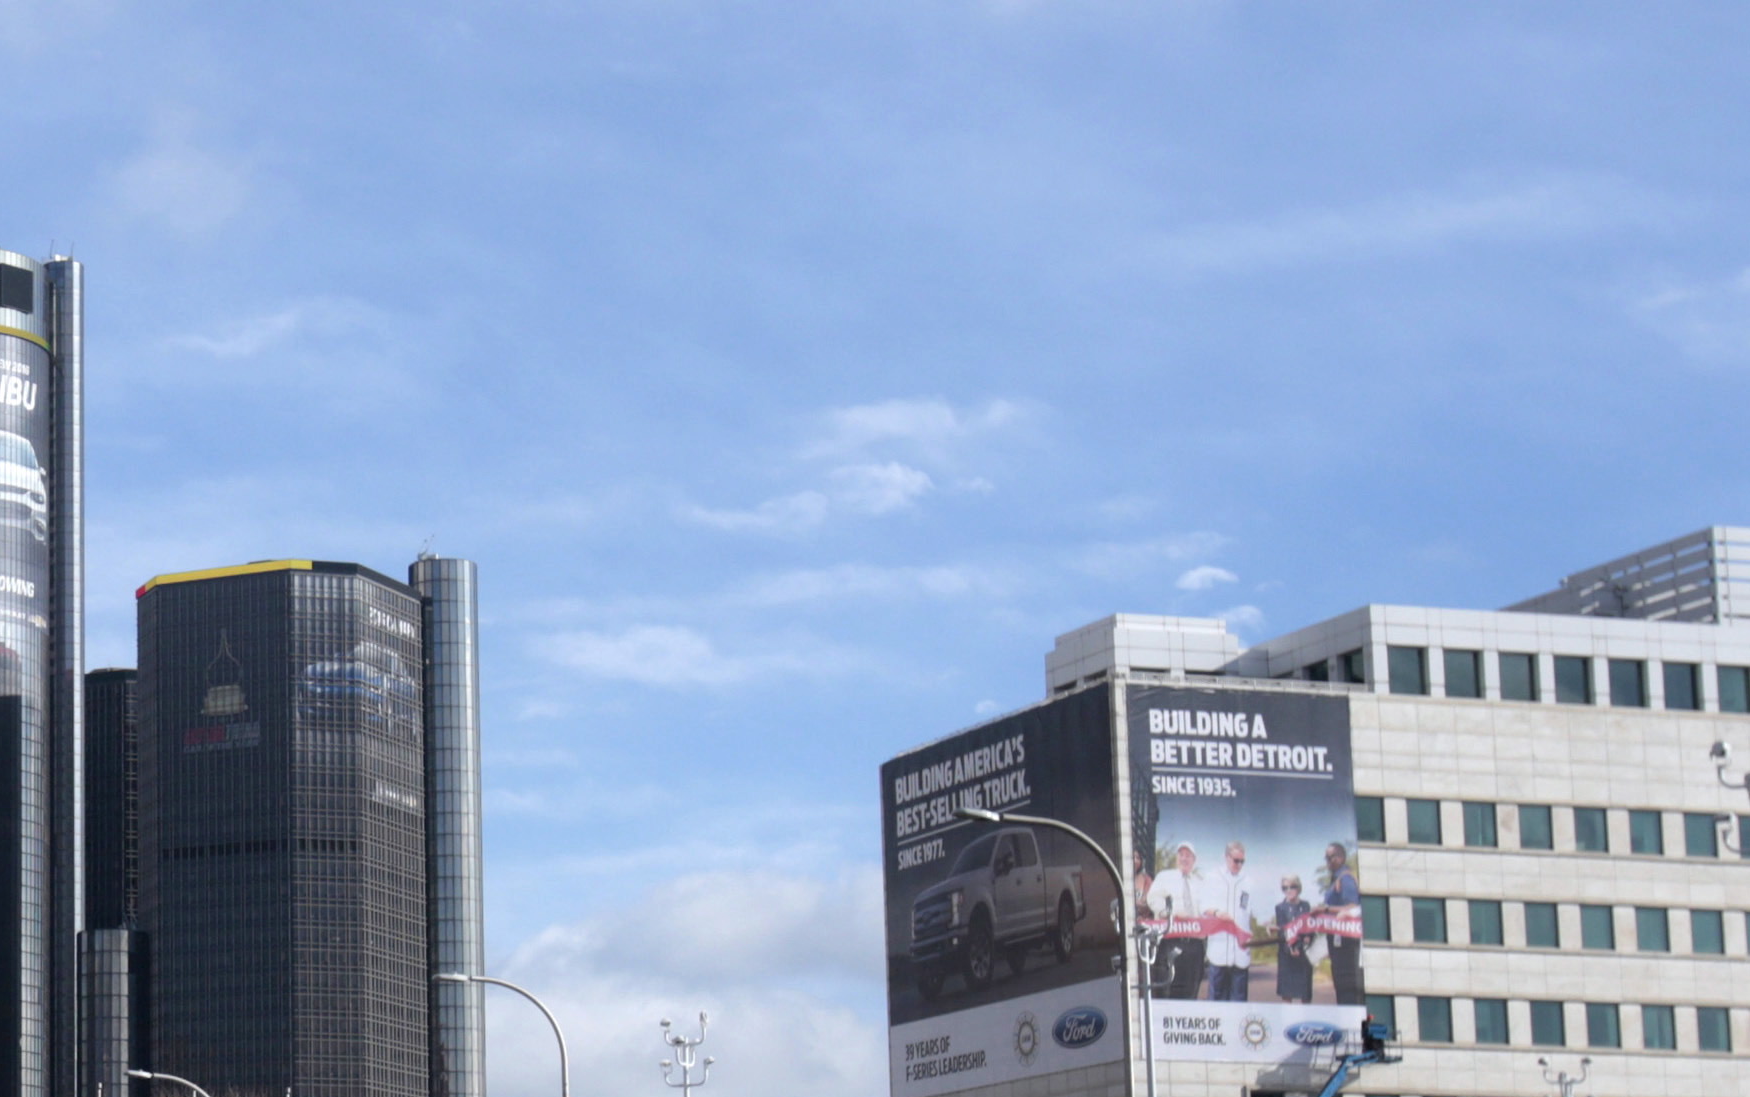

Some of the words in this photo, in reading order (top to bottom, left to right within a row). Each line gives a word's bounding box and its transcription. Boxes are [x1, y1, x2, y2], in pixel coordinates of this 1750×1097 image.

[1149, 708, 1249, 738] BUILDING
[1251, 713, 1268, 739] A
[895, 760, 952, 805] BUILDING
[954, 734, 1025, 785] AMERICA'S
[1150, 738, 1233, 767] BETTER
[1236, 743, 1333, 772] DETROIT.
[1152, 775, 1196, 795] SINCE
[1197, 777, 1237, 797] 1935.
[896, 783, 982, 838] BEST-SELLING
[983, 768, 1031, 809] TRUCK.
[898, 844, 923, 871] SINCE
[923, 838, 945, 864] 1977.
[1063, 1014, 1096, 1042] Ford
[1163, 1016, 1174, 1029] 81
[1175, 1017, 1206, 1031] YEARS
[1208, 1018, 1221, 1030] OF
[1296, 1025, 1333, 1043] Ford
[905, 1043, 914, 1061] 39
[915, 1037, 939, 1058] YEARS
[940, 1036, 950, 1054] OF
[1163, 1031, 1197, 1045] GIVING
[1199, 1032, 1226, 1046] BACK.
[906, 1060, 938, 1082] F-SERIES
[939, 1049, 987, 1076] LEADERSHIP.
